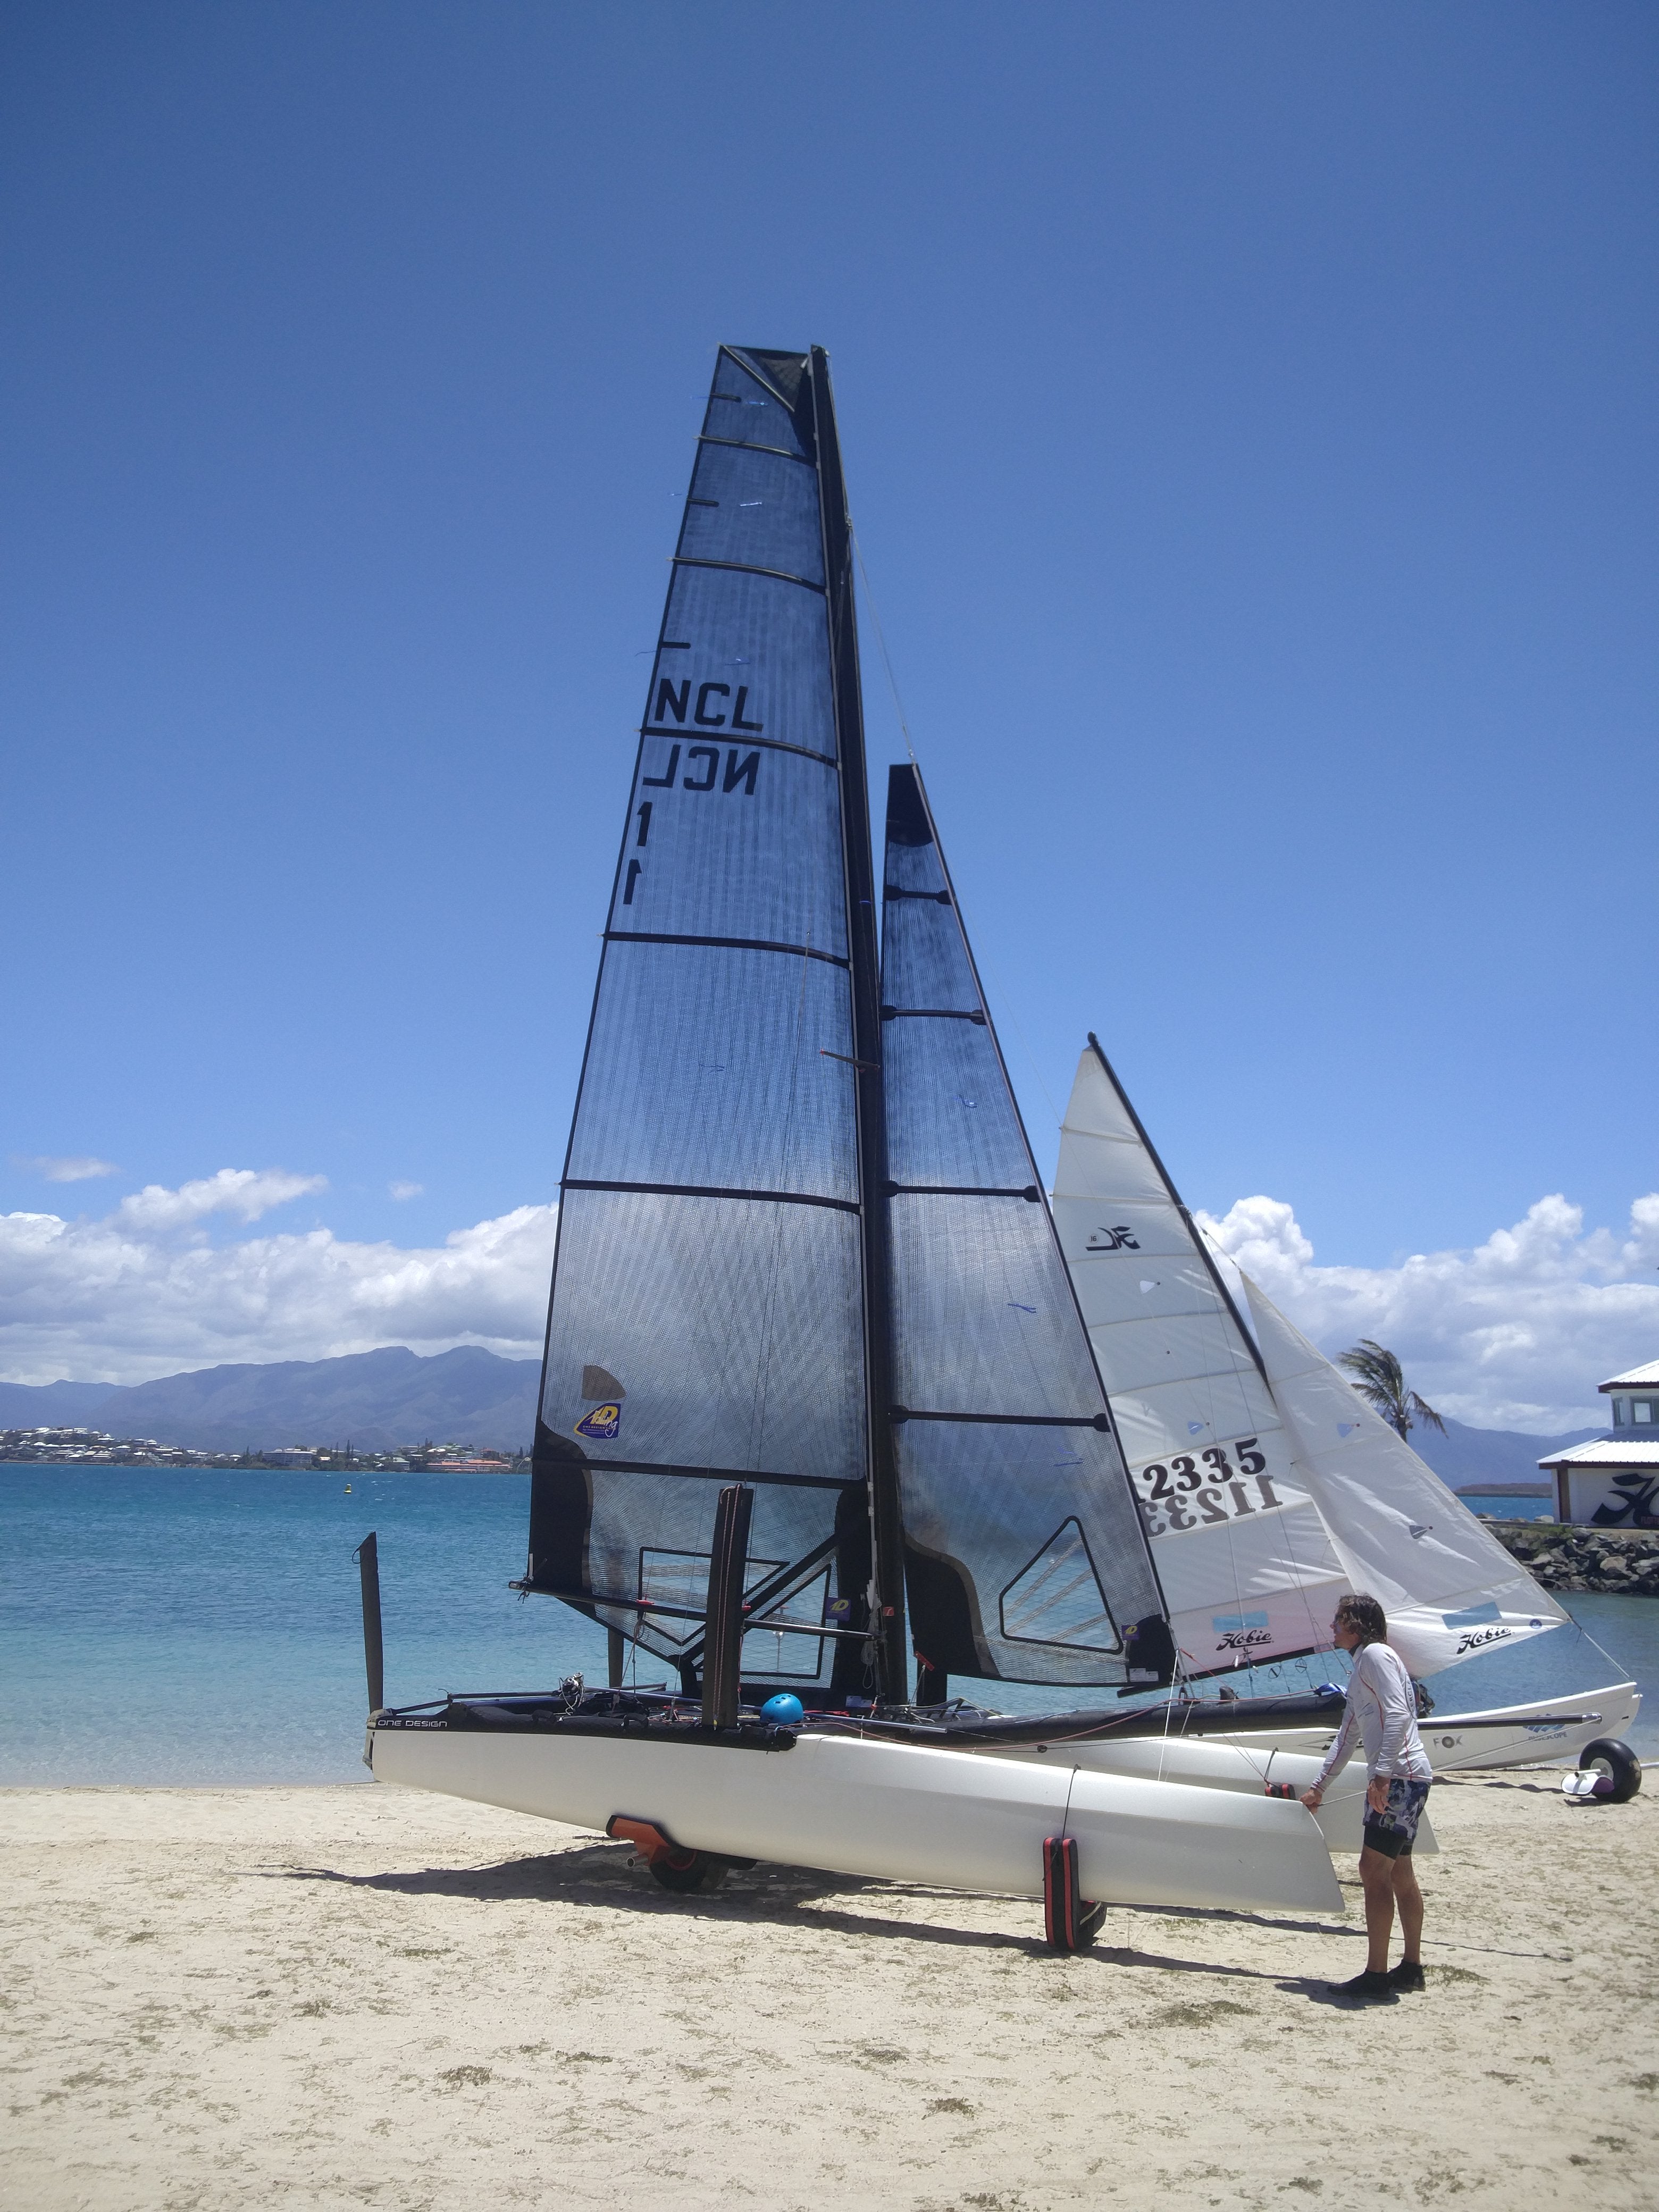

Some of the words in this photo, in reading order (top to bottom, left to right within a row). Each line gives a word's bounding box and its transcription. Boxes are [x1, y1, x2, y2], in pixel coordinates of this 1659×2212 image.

[654, 678, 764, 732] NCL
[636, 801, 652, 847] 1
[1138, 1437, 1266, 1504] 2335
[1216, 1629, 1272, 1651] Hobie
[1456, 1628, 1511, 1654] Hobie
